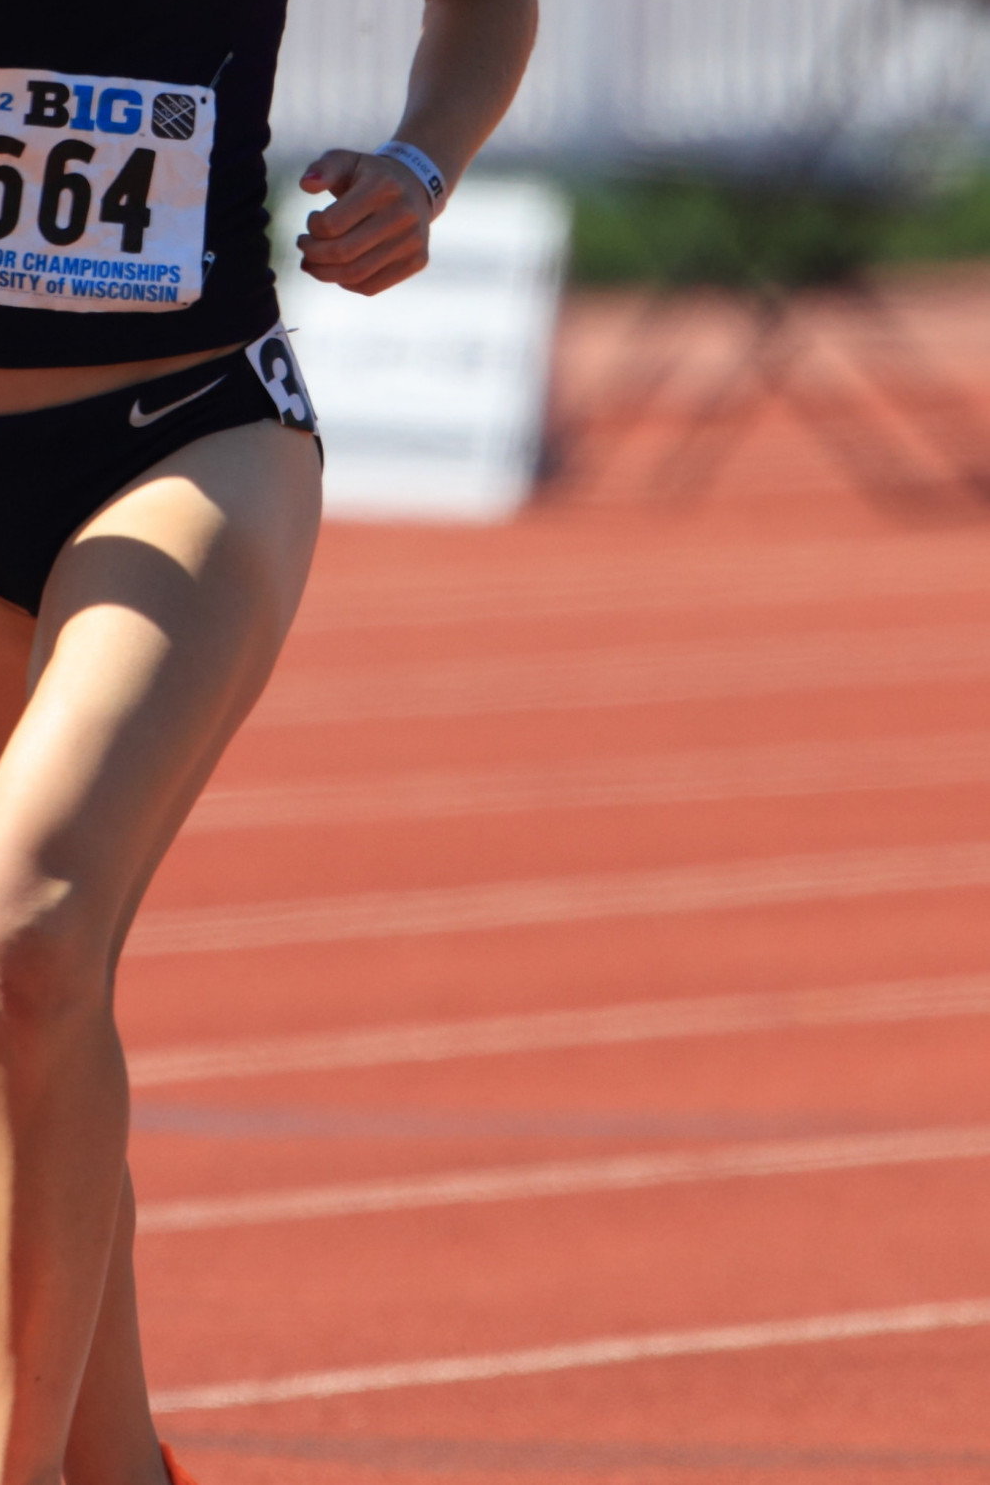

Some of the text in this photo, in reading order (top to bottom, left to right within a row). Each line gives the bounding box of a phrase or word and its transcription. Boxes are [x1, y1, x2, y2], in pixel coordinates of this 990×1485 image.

[22, 252, 182, 284] CHAMPIONSHIPS
[45, 276, 66, 295] of
[71, 279, 179, 304] WISCONSIN
[259, 337, 315, 433] 3
